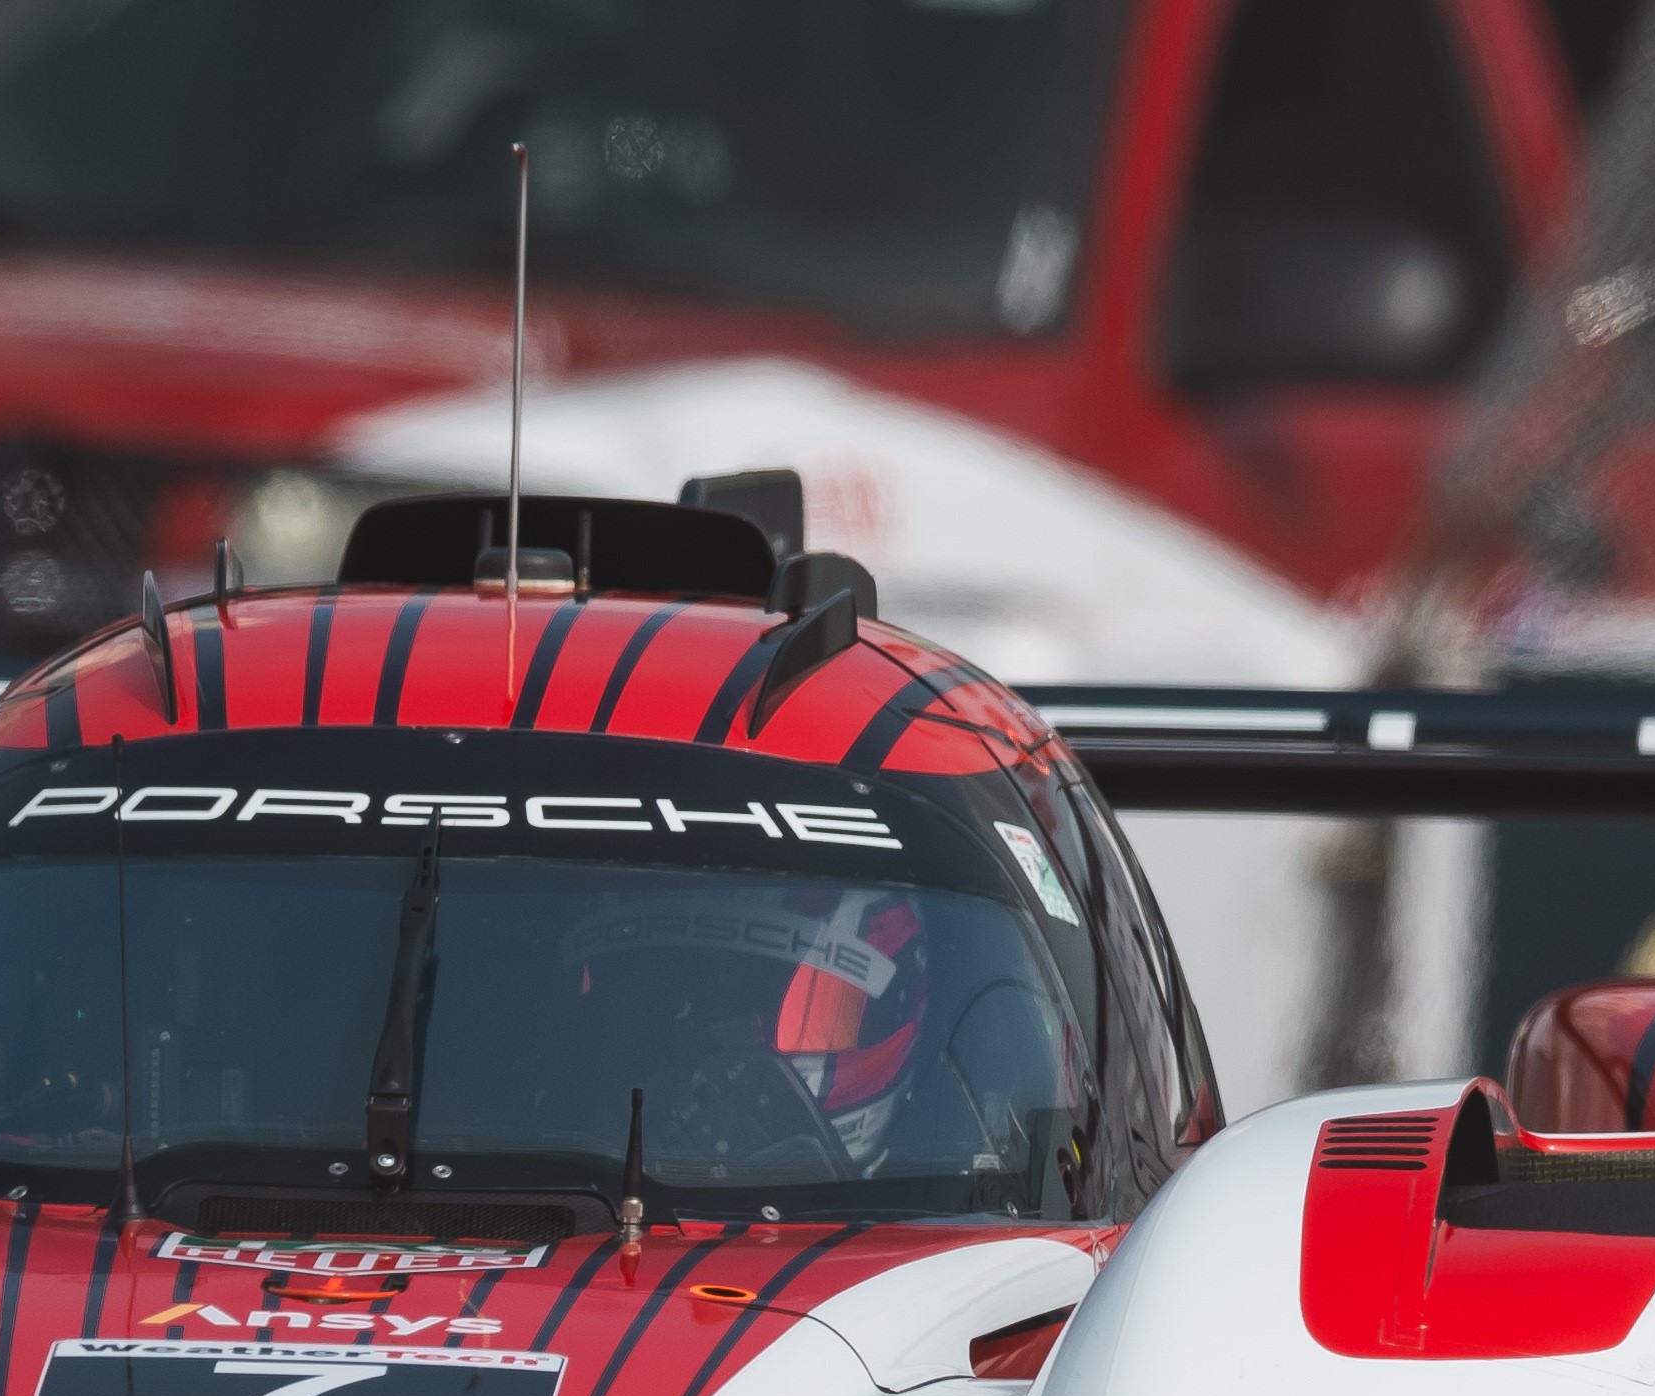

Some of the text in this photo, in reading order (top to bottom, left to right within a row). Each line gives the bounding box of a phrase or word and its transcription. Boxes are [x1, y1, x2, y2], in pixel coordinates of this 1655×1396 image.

[8, 786, 903, 849] PORSCHE
[139, 1303, 503, 1337] Ansys
[80, 1343, 540, 1367] WeatherTech
